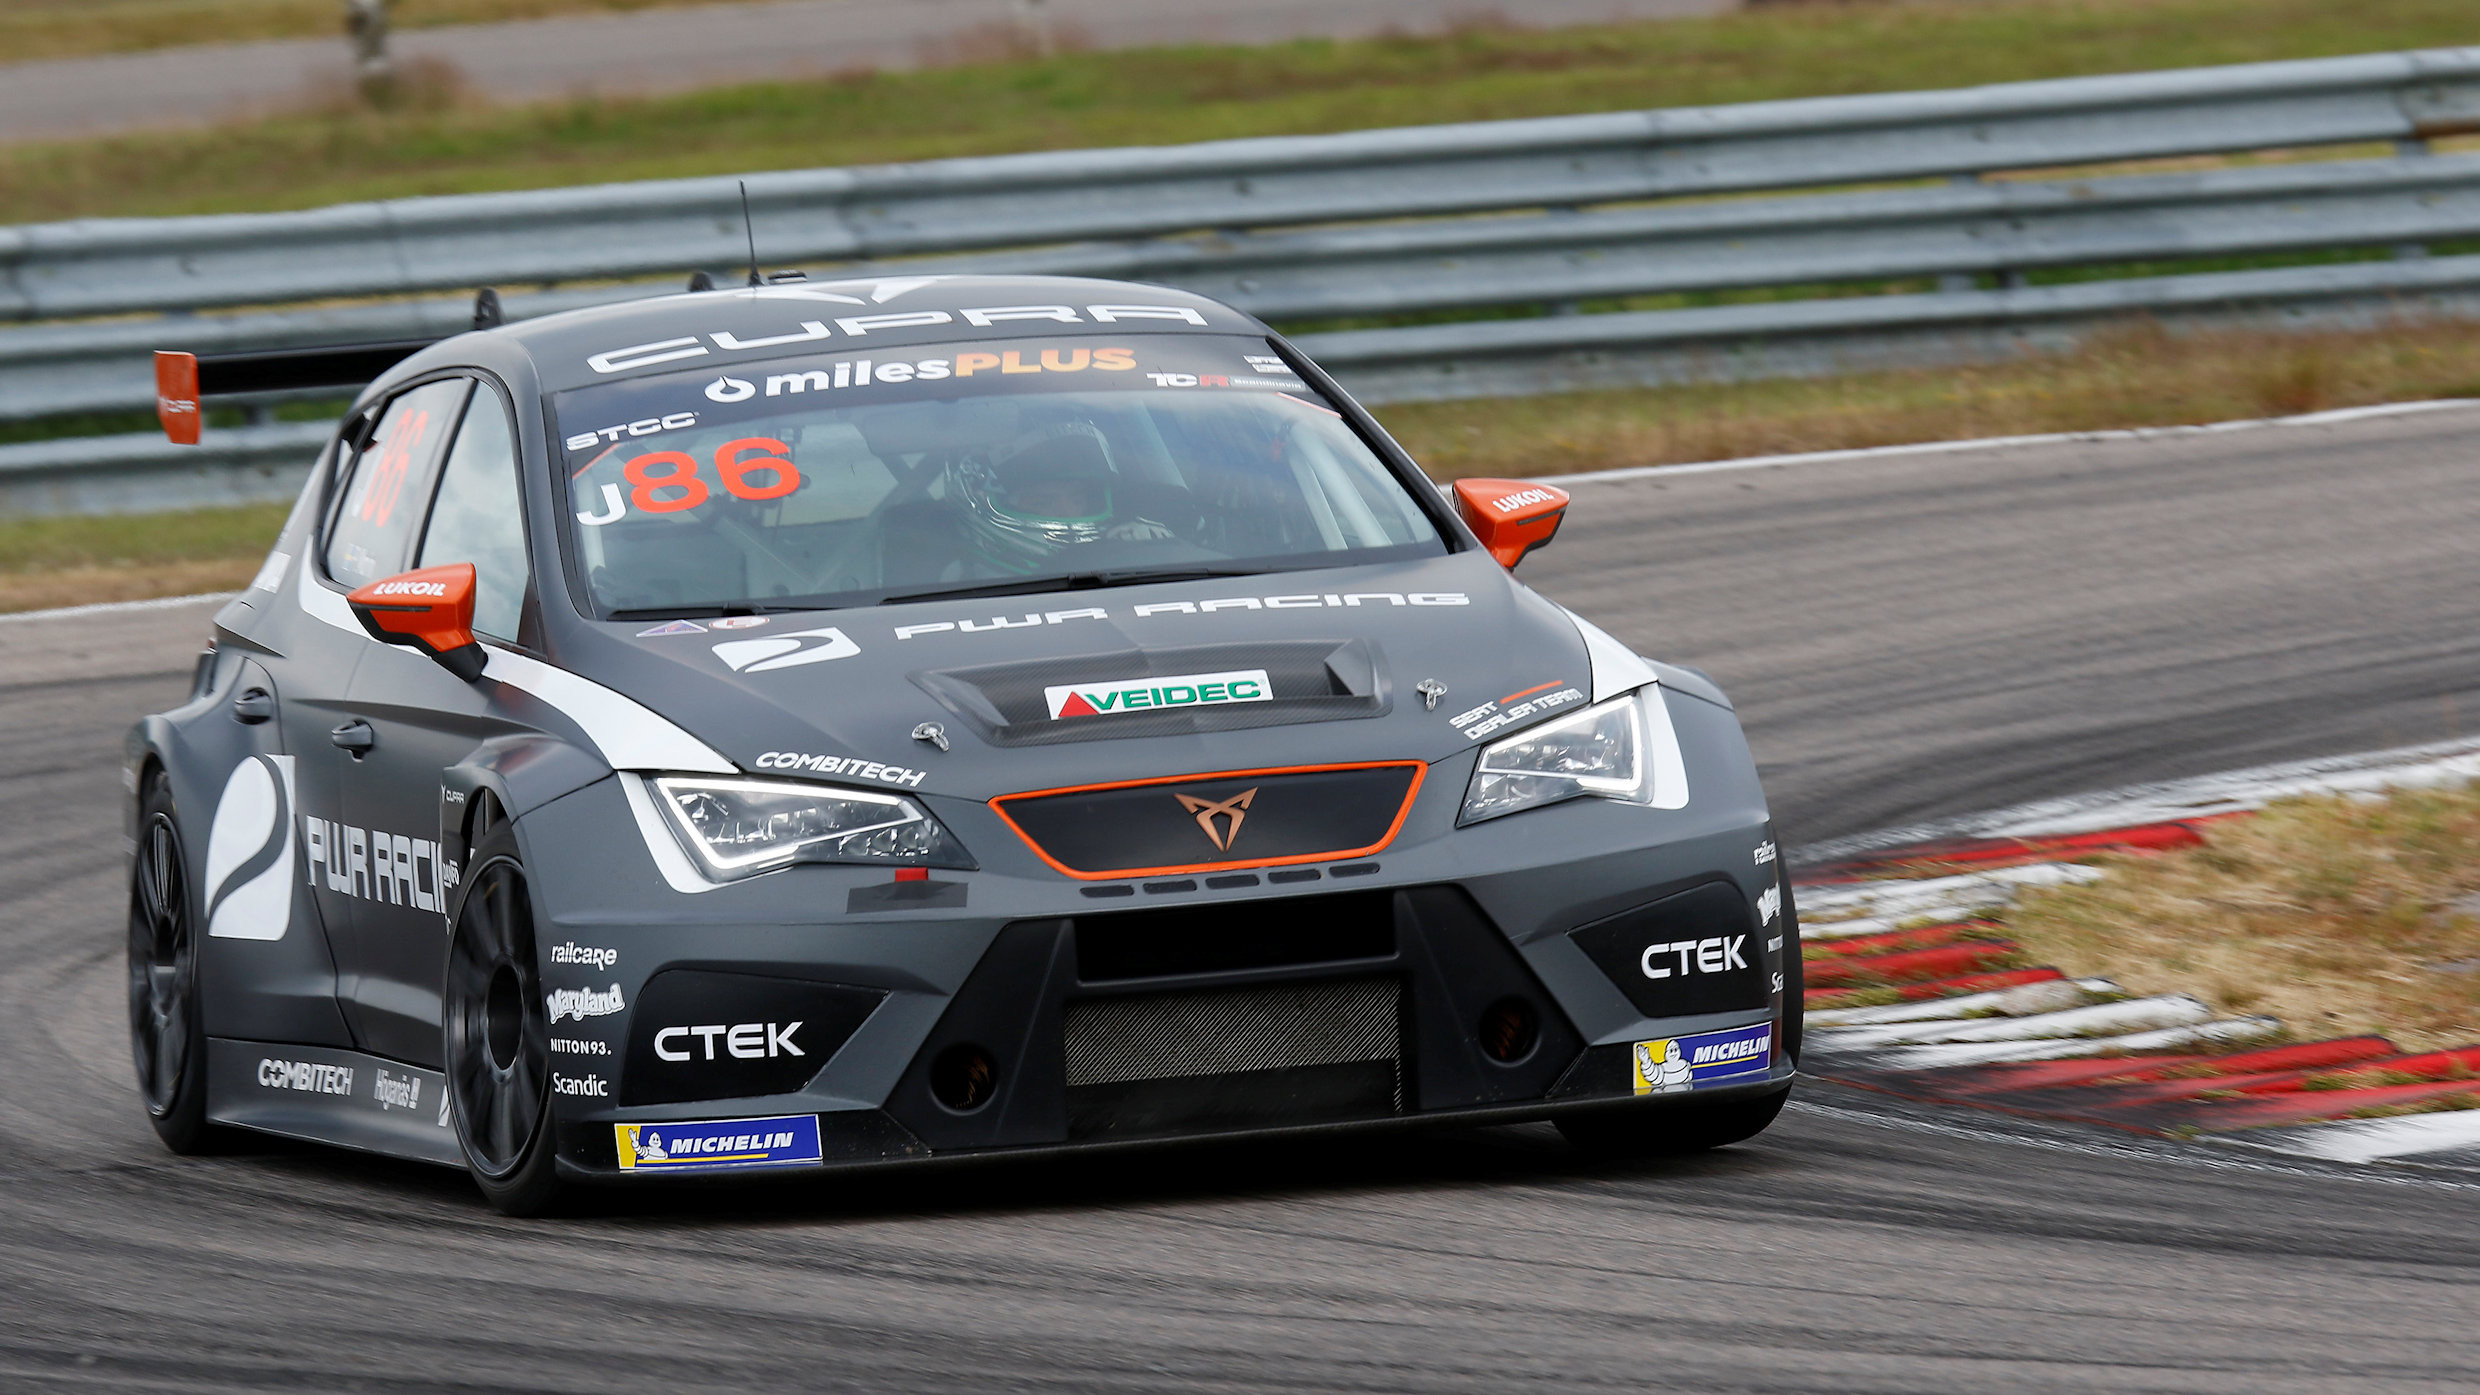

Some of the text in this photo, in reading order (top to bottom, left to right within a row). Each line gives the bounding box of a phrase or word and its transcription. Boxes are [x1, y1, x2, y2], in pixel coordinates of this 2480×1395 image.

[587, 304, 1208, 373] CUPRA
[765, 348, 1137, 398] milesPLUS
[1146, 373, 1229, 387] TCR
[566, 411, 696, 451] STCC
[1492, 488, 1555, 514] LUKOIL
[373, 582, 447, 597] LUKOIL
[894, 592, 1470, 640] PWR RACING
[1084, 680, 1261, 710] VEIDEC
[1449, 701, 1497, 729] SEAT
[1464, 688, 1583, 740] DEALER TEAM
[755, 751, 926, 788] COMBITECH
[306, 815, 371, 901] PWR
[551, 942, 617, 971] railcare
[1641, 934, 1747, 979] CTEK
[546, 983, 626, 1024] Maryland
[654, 1021, 805, 1062] CTEK
[1693, 1034, 1771, 1063] MICHELIN
[258, 1058, 354, 1096] COMBITECH
[553, 1072, 608, 1097] Scandic
[670, 1131, 795, 1154] MICHELIN
